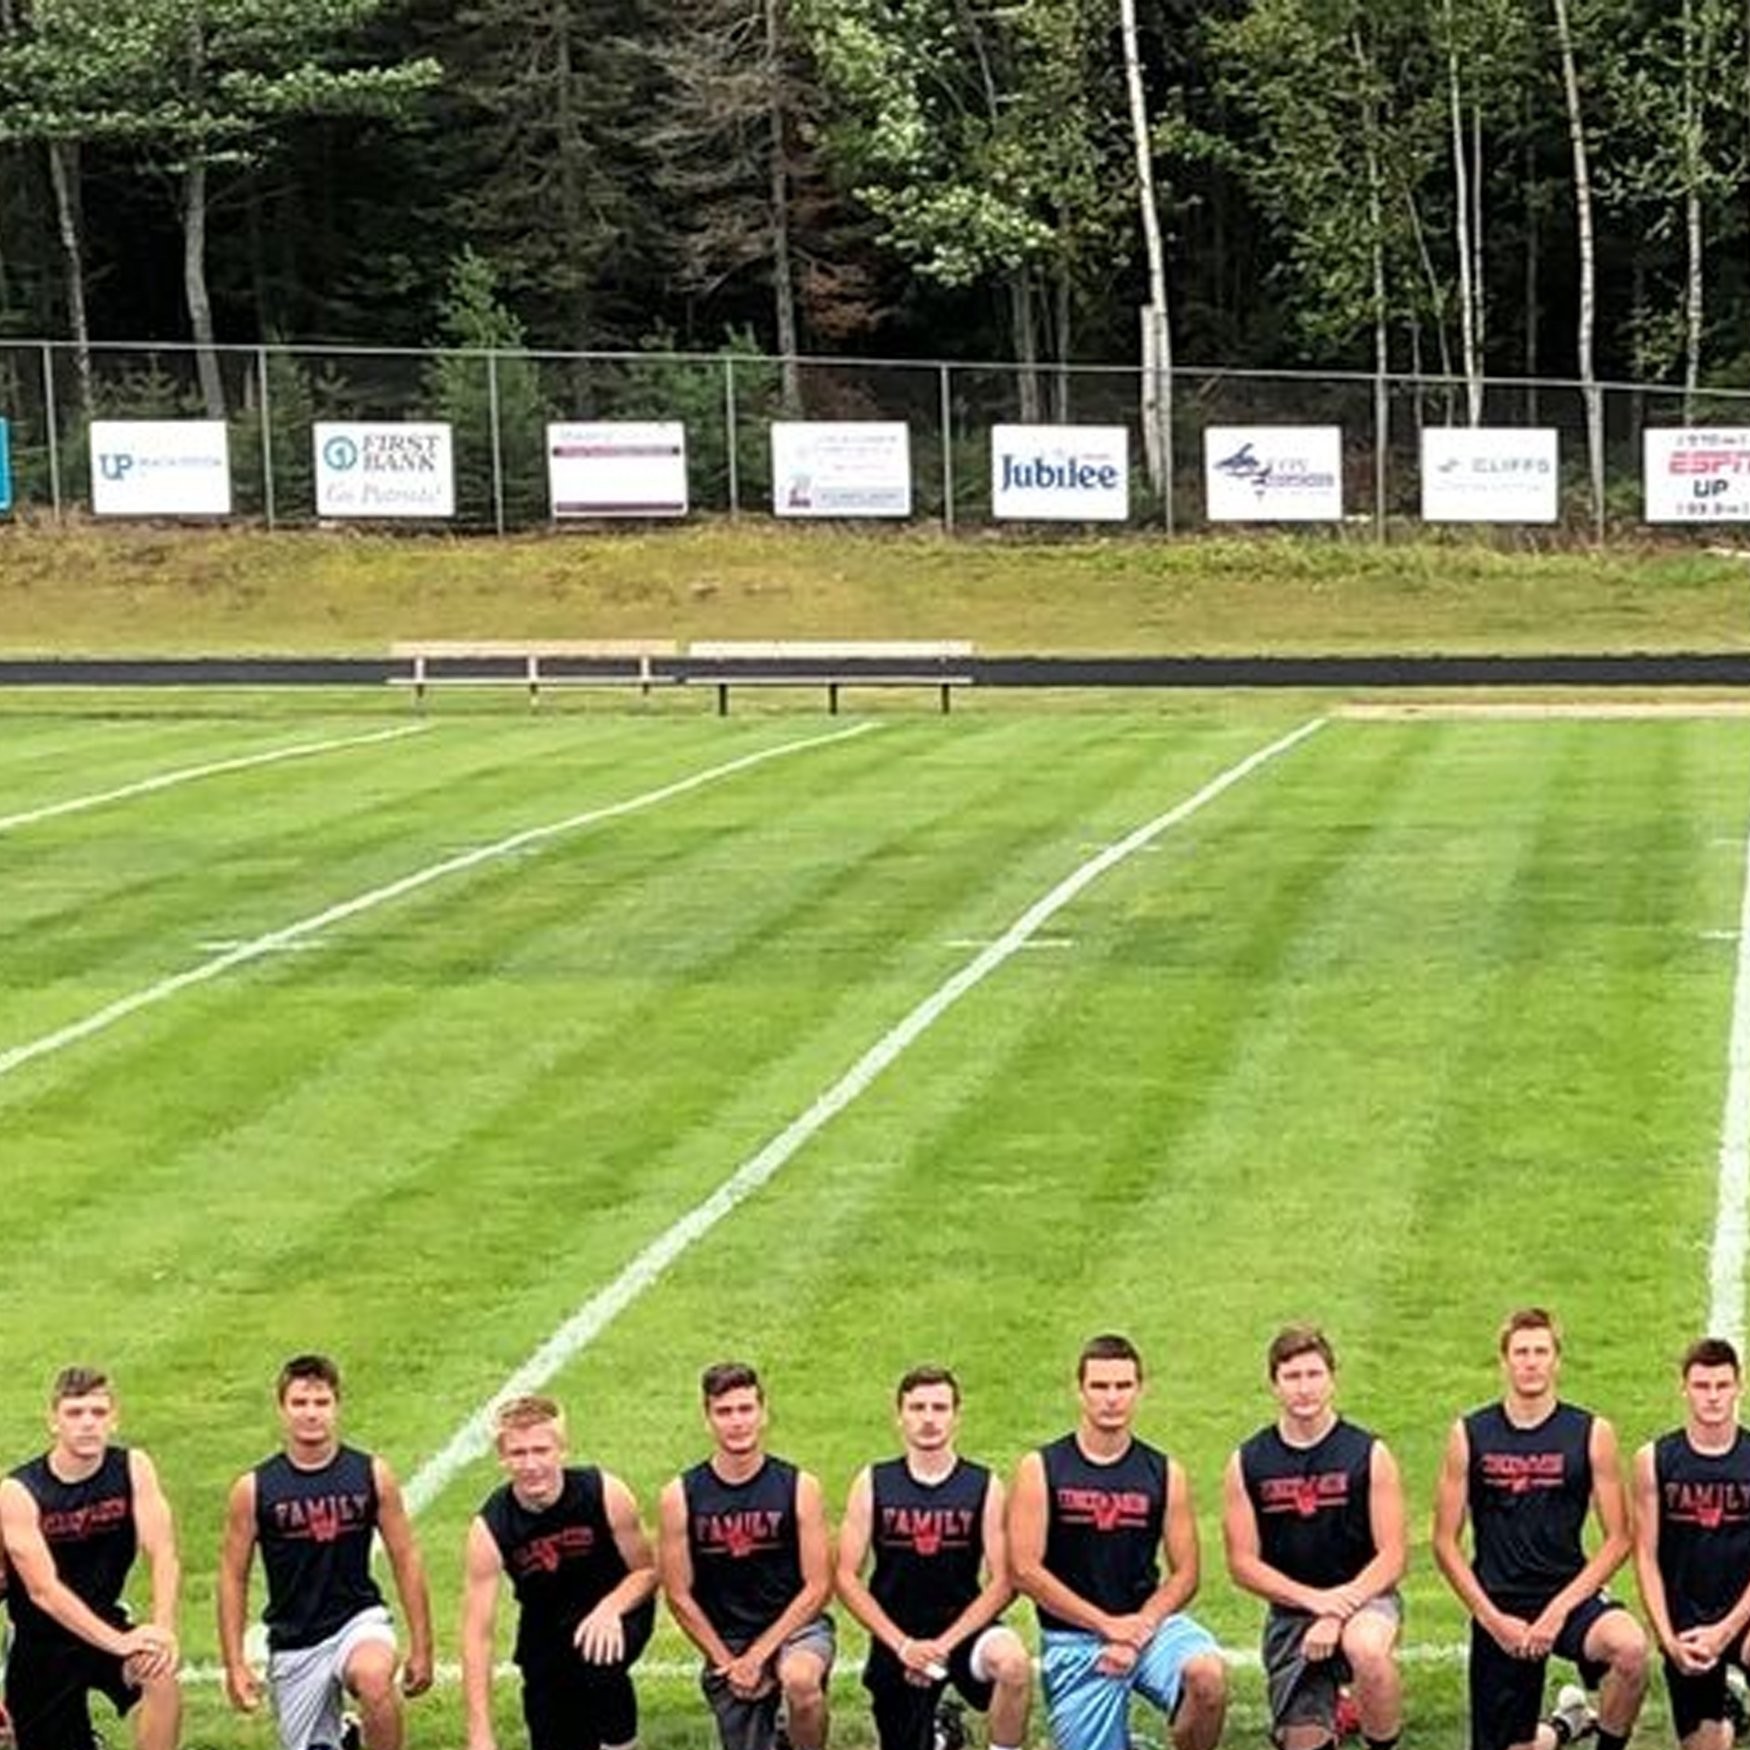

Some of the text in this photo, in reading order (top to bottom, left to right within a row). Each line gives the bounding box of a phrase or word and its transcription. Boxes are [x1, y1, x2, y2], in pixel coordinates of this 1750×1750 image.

[361, 435, 441, 453] FIRST
[99, 454, 137, 480] UP
[362, 453, 436, 473] BANK
[1001, 453, 1121, 491] Jubilee
[1693, 479, 1729, 499] UP
[273, 1493, 369, 1529] FAMILY
[695, 1509, 784, 1541] FAMILY
[881, 1506, 975, 1536] FAMILY
